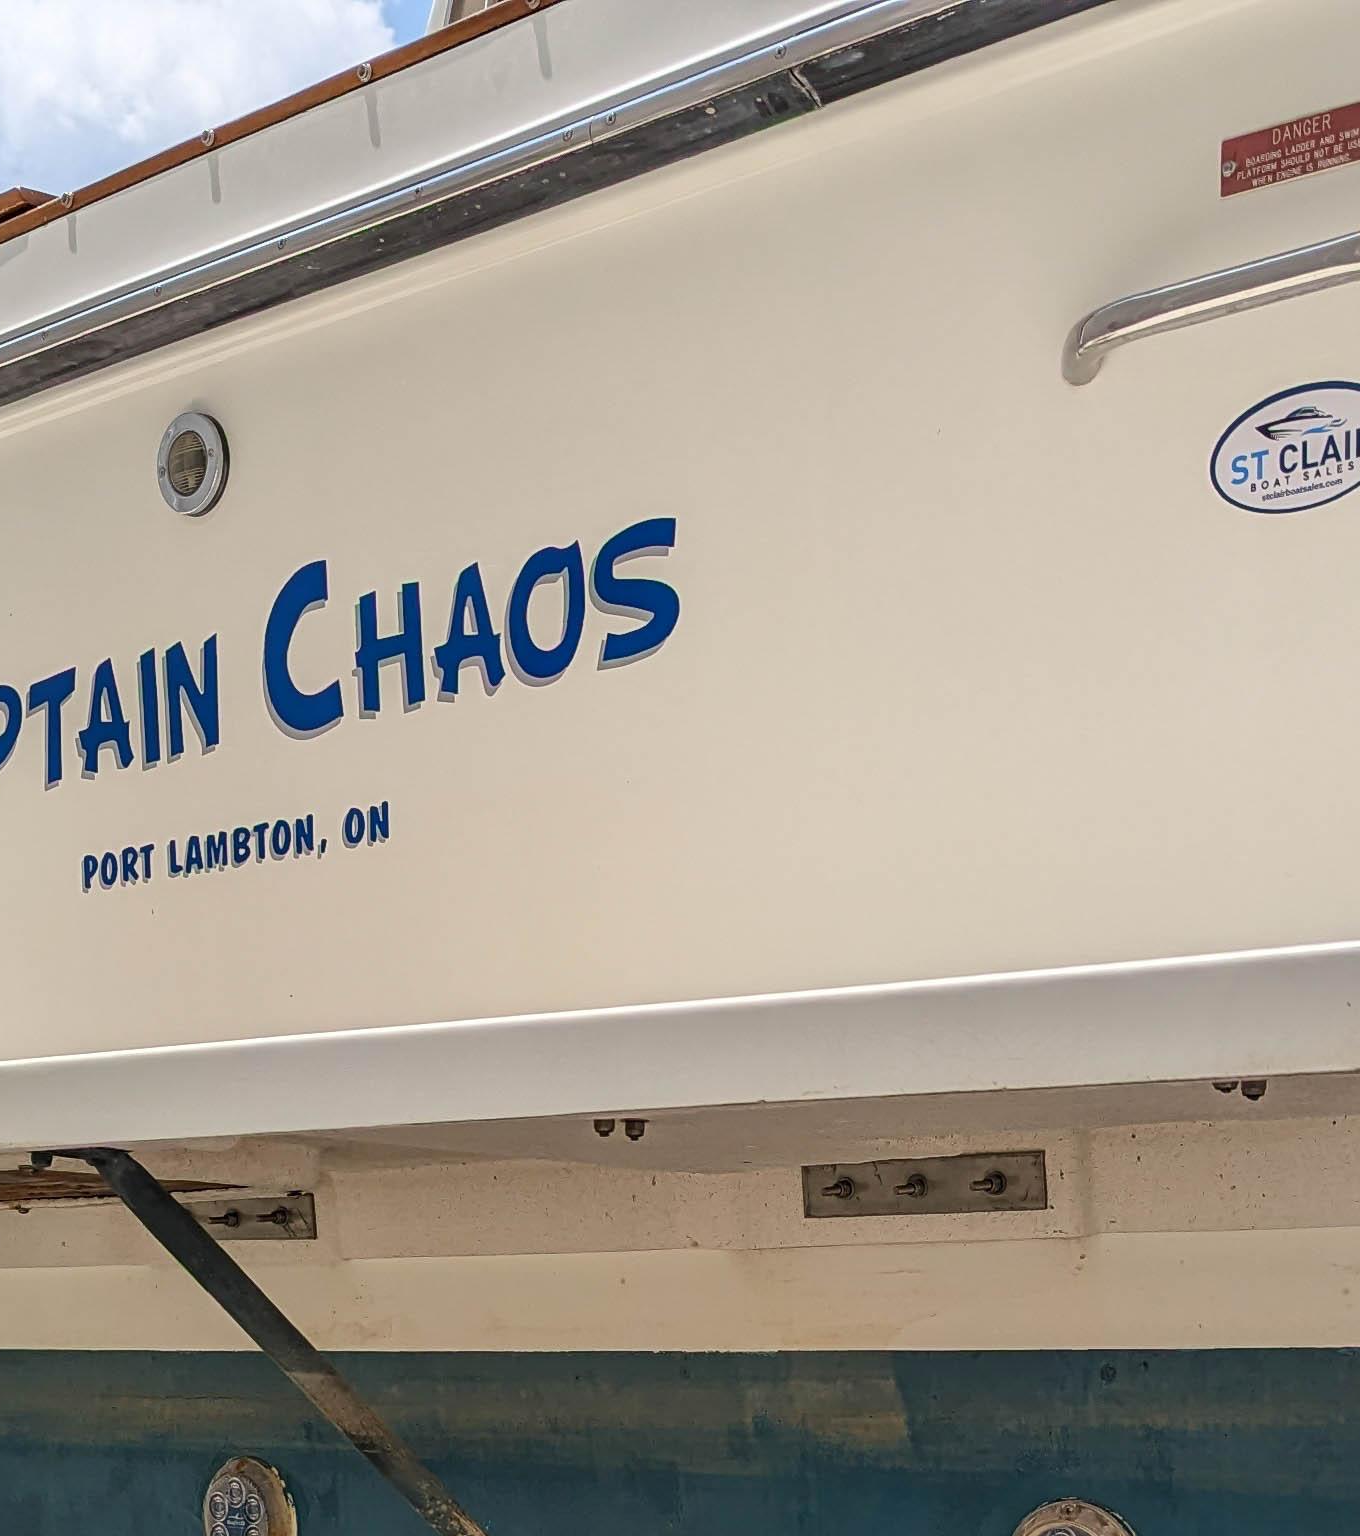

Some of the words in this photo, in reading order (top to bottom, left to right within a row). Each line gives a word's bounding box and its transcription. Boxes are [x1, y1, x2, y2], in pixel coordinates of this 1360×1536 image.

[1245, 149, 1282, 168] BOARDING
[1285, 139, 1315, 156] LADDER
[1320, 134, 1335, 146] AND
[1339, 127, 1360, 141] SWIM
[1272, 113, 1332, 145] DANGER
[1236, 161, 1278, 181] PLATFORM
[1280, 152, 1311, 169] SHOULD
[1313, 146, 1331, 159] NOT
[1333, 143, 1343, 154] BE
[1251, 174, 1273, 188] WHEN
[1231, 449, 1269, 485] ST
[1250, 475, 1291, 493] BOAT
[1303, 460, 1355, 481] SALES
[263, 517, 681, 741] CHAOS
[82, 844, 155, 893] PORT
[167, 814, 327, 878] LAMBTON,
[342, 801, 389, 849] ON
